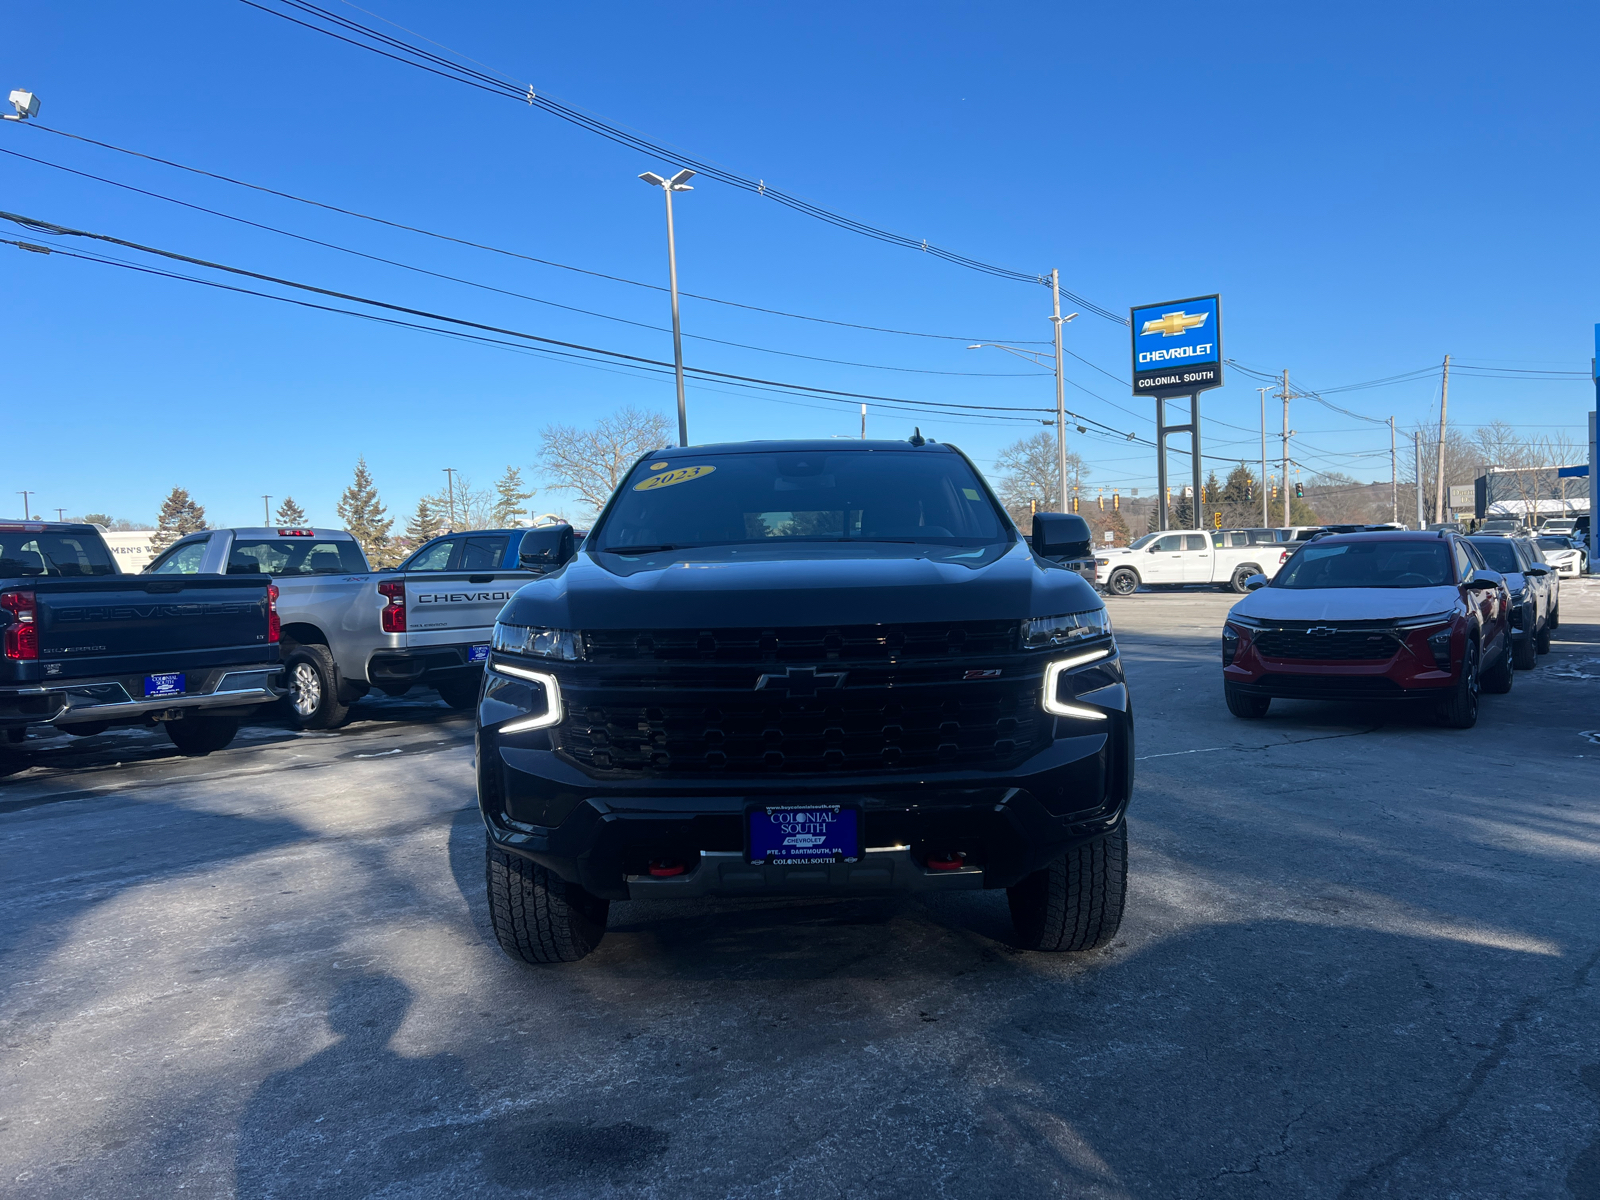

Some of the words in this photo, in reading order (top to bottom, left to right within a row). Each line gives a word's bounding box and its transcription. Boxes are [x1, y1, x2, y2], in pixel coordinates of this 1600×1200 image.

[1138, 343, 1213, 363] CHEVROLET
[1138, 375, 1181, 388] COLONIAL
[1183, 371, 1214, 382] SOUTH
[646, 467, 701, 489] 2023
[111, 546, 142, 554] MEN'S
[58, 602, 252, 621] CHEVROLET
[43, 645, 107, 654] SILVERADO
[770, 812, 837, 824] COLONIAL
[781, 823, 827, 834] SOUTH
